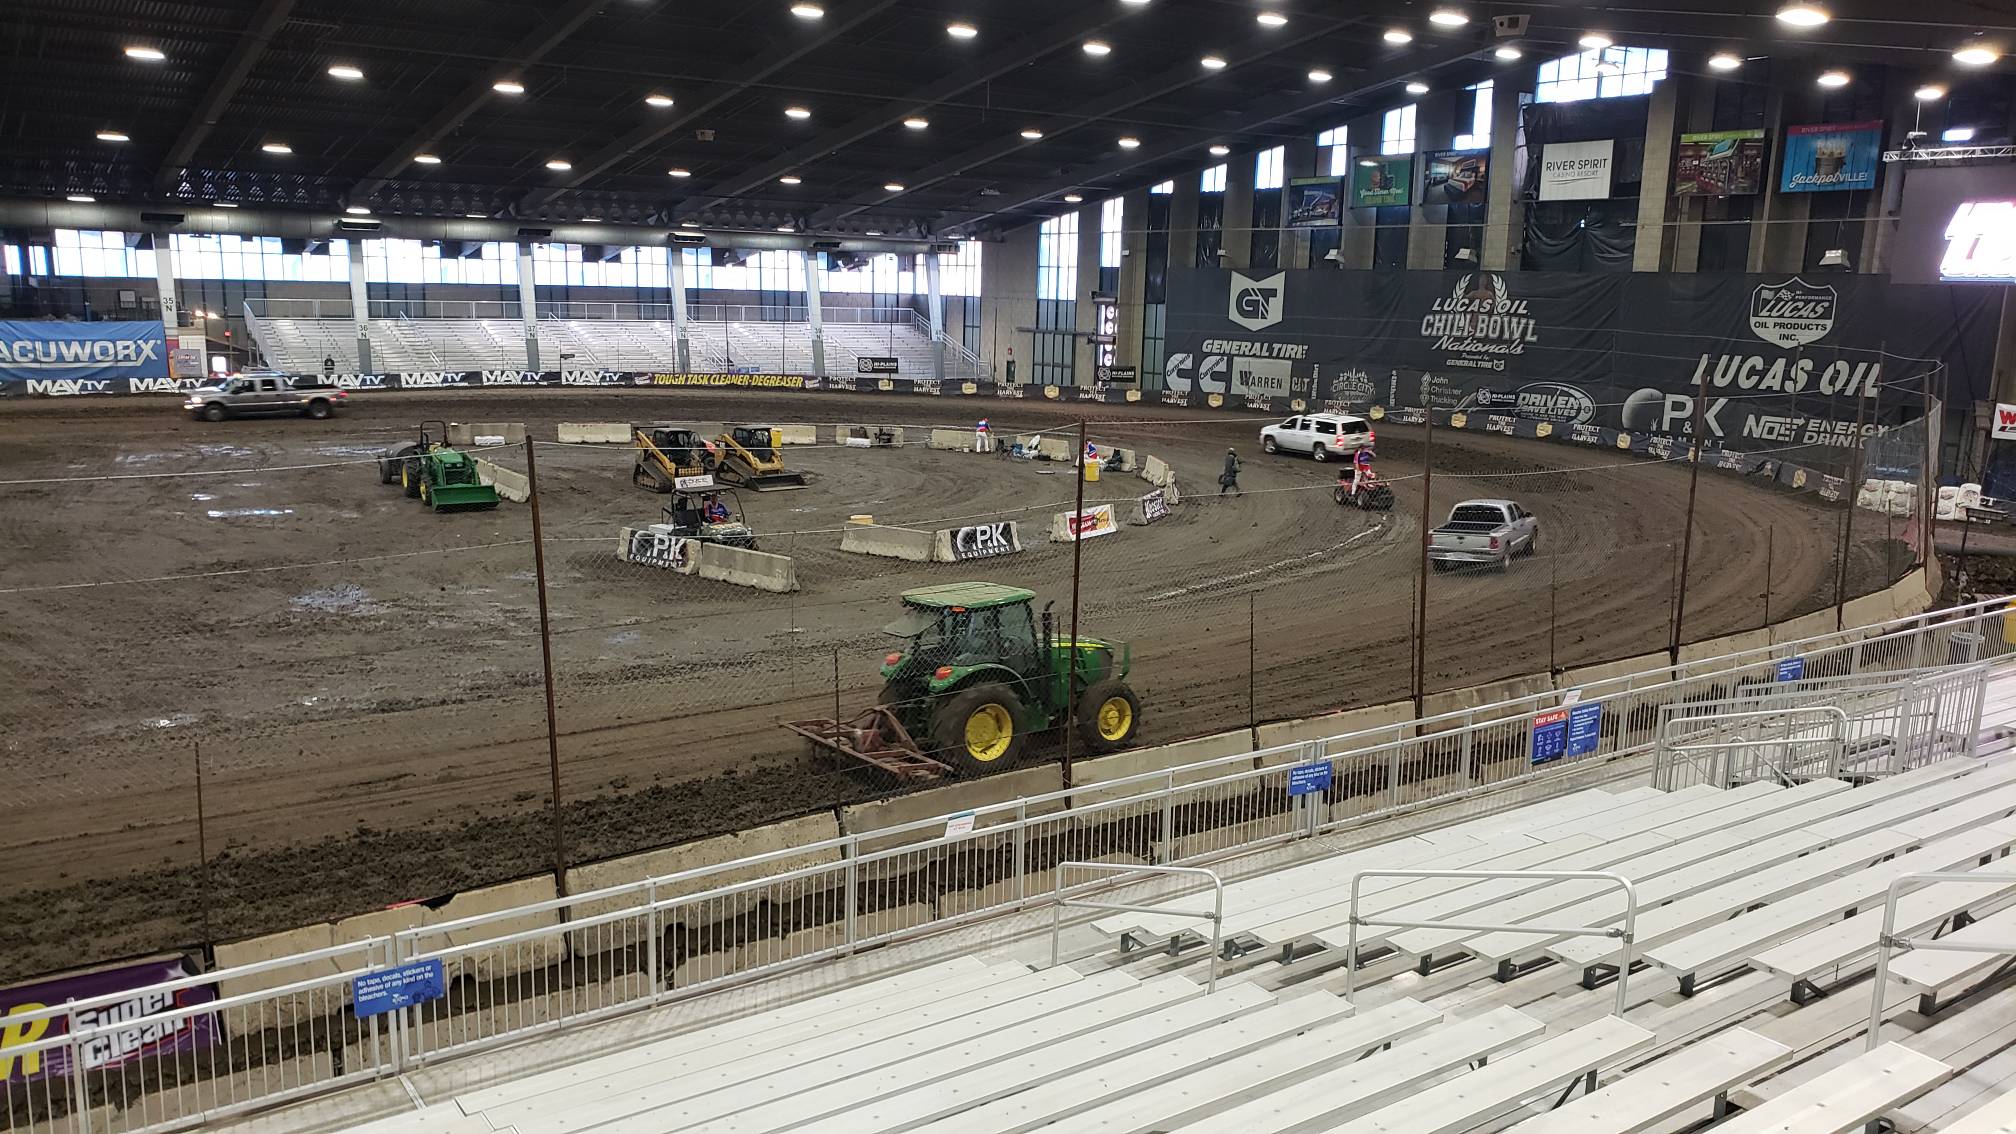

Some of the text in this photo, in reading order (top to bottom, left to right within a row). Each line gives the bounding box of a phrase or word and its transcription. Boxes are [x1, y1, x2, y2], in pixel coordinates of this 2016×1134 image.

[1546, 158, 1608, 171] RIVER SPIRIT
[1432, 298, 1529, 314] LUCAS OIL
[1758, 300, 1830, 318] LUCAS
[1420, 314, 1539, 342] CHILI BOWL
[1754, 321, 1827, 331] OIL PRODUCTS
[1431, 334, 1524, 355] Nationals
[1778, 333, 1799, 342] INC.
[1201, 339, 1308, 359] GENERAL TIRE
[1166, 353, 1191, 377] Cummins
[1199, 356, 1225, 380] Cummins
[1446, 359, 1493, 369] GENERAL TIRE
[654, 373, 686, 385] TOUGH
[687, 374, 709, 385] TASK
[710, 374, 803, 388] CLEANER-DEGREASER
[1239, 370, 1283, 390] WARREN
[1431, 376, 1449, 385] John
[1690, 353, 1881, 398] LUCAS OIL
[1332, 381, 1357, 393] CIRCLE
[1357, 383, 1375, 395] CITY
[1430, 386, 1462, 396] Christner
[1430, 395, 1458, 405] Trucking
[1517, 393, 1580, 409] DRIVEN
[1548, 407, 1577, 416] LIVES
[1661, 393, 1730, 437] P&K
[1486, 423, 1515, 432] HARVEST
[1573, 424, 1600, 432] PROTECT
[1743, 414, 1800, 441] NOS
[1808, 419, 1890, 438] ENERGY
[1571, 433, 1598, 442] HARVEST
[1803, 432, 1866, 450] DRINK
[976, 523, 1009, 549] P&K
[652, 533, 683, 560] P&K
[961, 545, 1011, 559] EQUIPMENT
[629, 554, 683, 569] EQUIPMENT
[1535, 713, 1559, 725] STAY SAFE
[357, 980, 366, 988] No
[382, 972, 402, 982] decals,
[402, 967, 425, 977] stickers
[358, 984, 384, 995] adhesive
[391, 979, 402, 987] any
[402, 976, 416, 984] kind
[358, 991, 388, 1002] bleachers.
[74, 989, 174, 1031] Super
[82, 1017, 187, 1069] Clean
